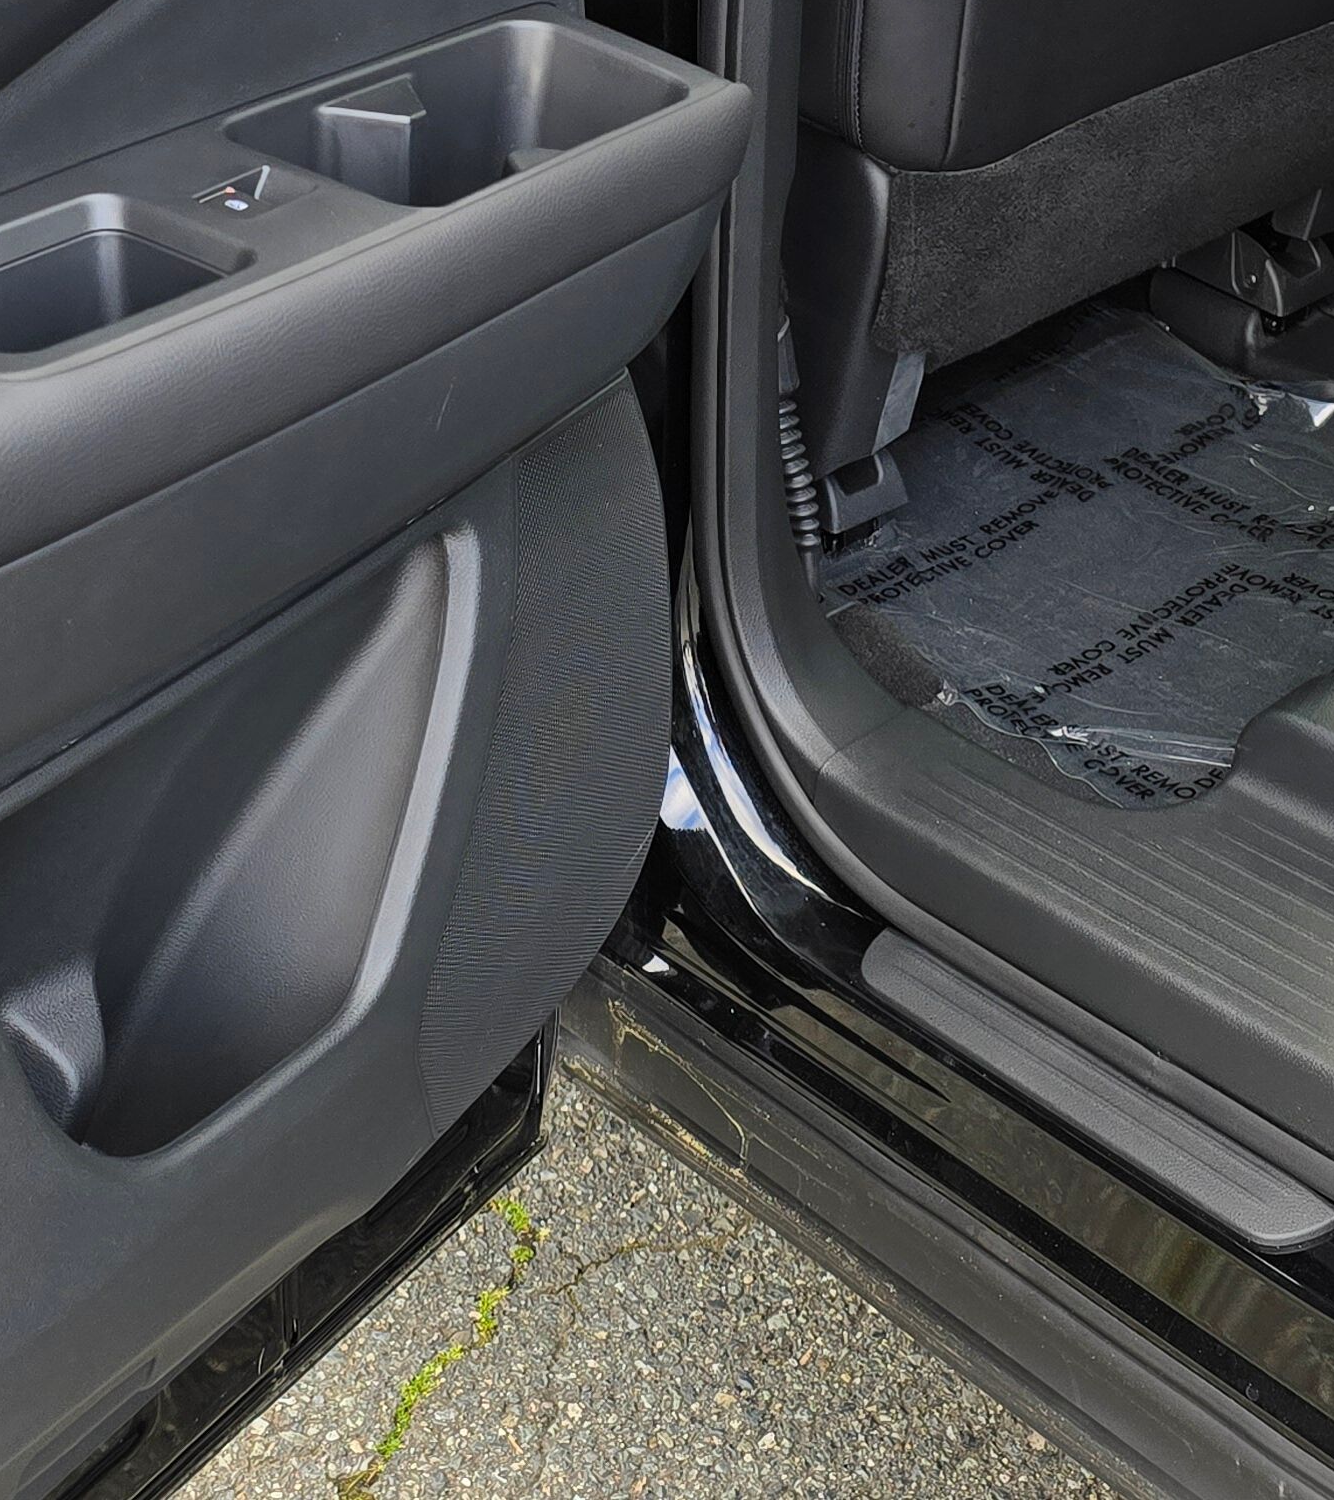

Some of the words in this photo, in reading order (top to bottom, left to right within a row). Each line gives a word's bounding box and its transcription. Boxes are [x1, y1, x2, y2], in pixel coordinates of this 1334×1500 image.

[973, 437, 1030, 470] MUST
[1013, 439, 1115, 490] PROTECTIVE
[1030, 467, 1096, 503] DEALER
[1103, 457, 1210, 515] PROTECTIVE
[1121, 447, 1189, 486] DEALER
[1193, 486, 1251, 515] MUST
[838, 555, 916, 597] DEALER
[920, 534, 977, 564] MUST
[979, 489, 1060, 536] REMOVE
[857, 555, 973, 605] PROTECTIVE
[974, 518, 1040, 559] COVER
[1175, 582, 1250, 628] DEALER
[1220, 563, 1303, 606] REMOVE
[1047, 639, 1116, 676] COVER
[1116, 626, 1175, 664] MUST
[985, 683, 1059, 729] DEALER
[1131, 764, 1197, 800] REMO
[1084, 757, 1156, 800] COVER
